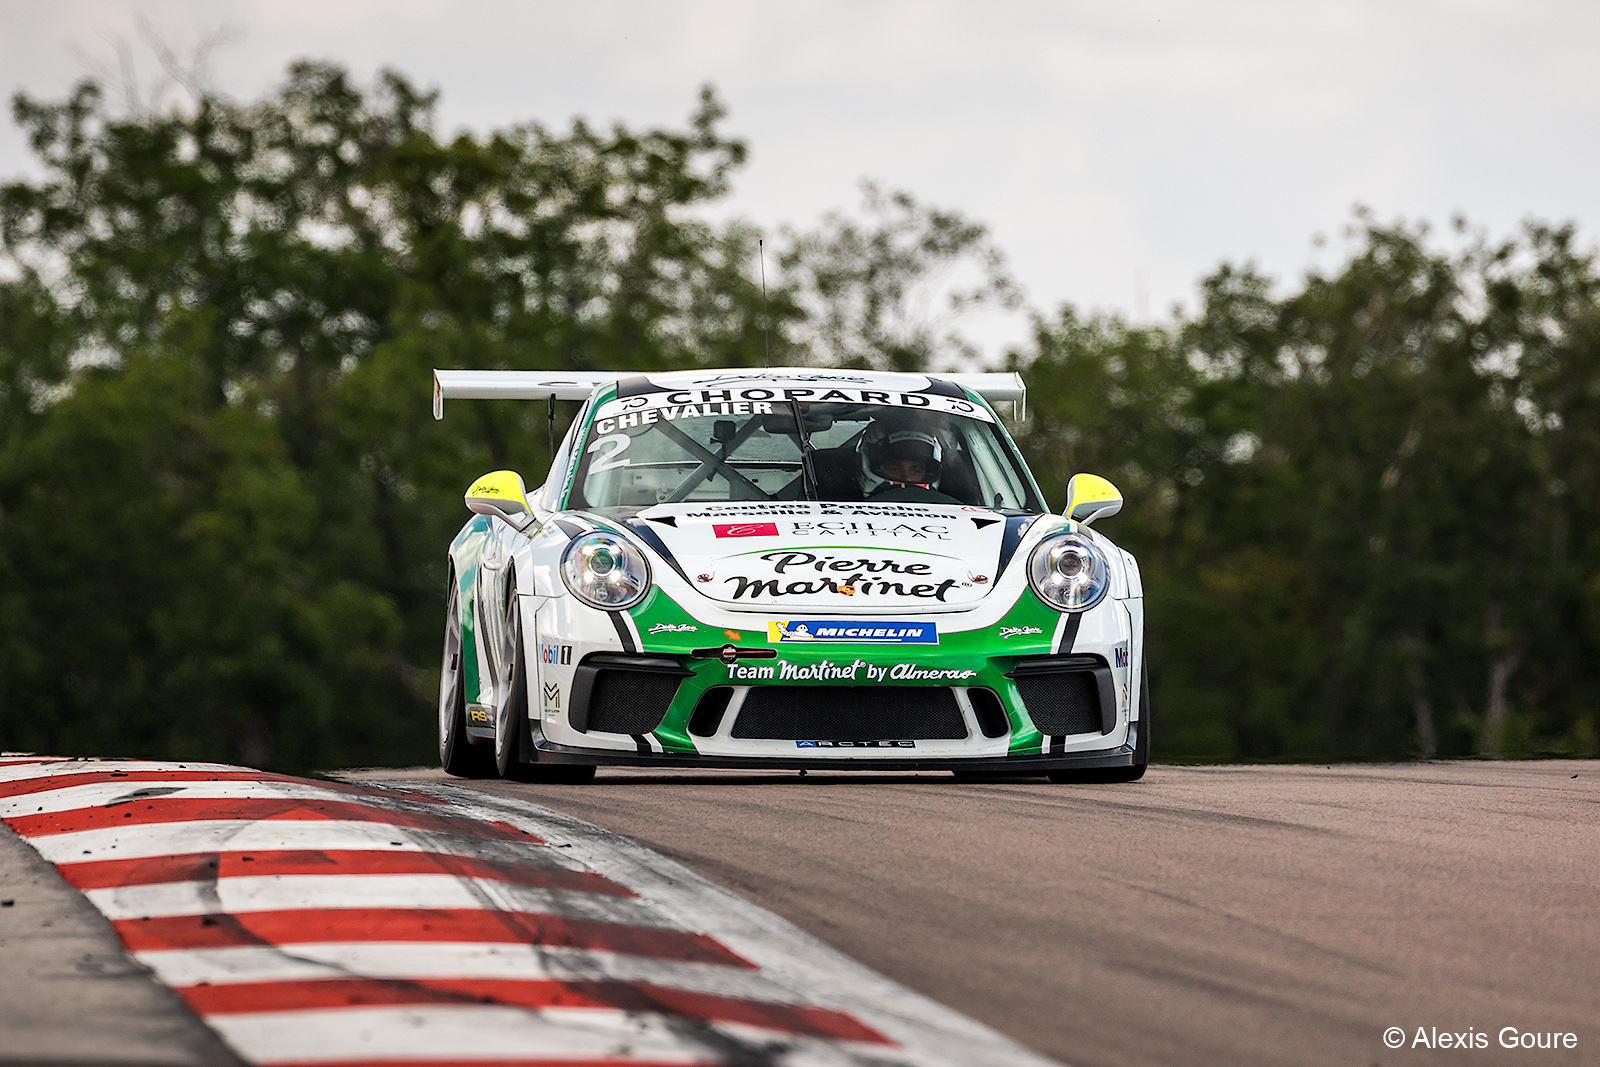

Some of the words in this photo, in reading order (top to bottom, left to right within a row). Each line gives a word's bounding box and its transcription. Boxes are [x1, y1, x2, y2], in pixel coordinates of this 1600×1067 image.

[666, 388, 930, 407] CHOPARD
[596, 401, 773, 435] CHEVALIER
[587, 433, 631, 476] 2
[686, 510, 811, 518] Marseille
[705, 504, 811, 512] Centres
[819, 503, 930, 512] Porsche
[791, 530, 952, 541] CAPITAL
[760, 551, 932, 575] Pierre
[816, 627, 924, 639] MICHELIN
[727, 663, 774, 680] Team
[867, 664, 889, 682] by
[889, 663, 977, 680] Almeras
[470, 710, 488, 722] RS
